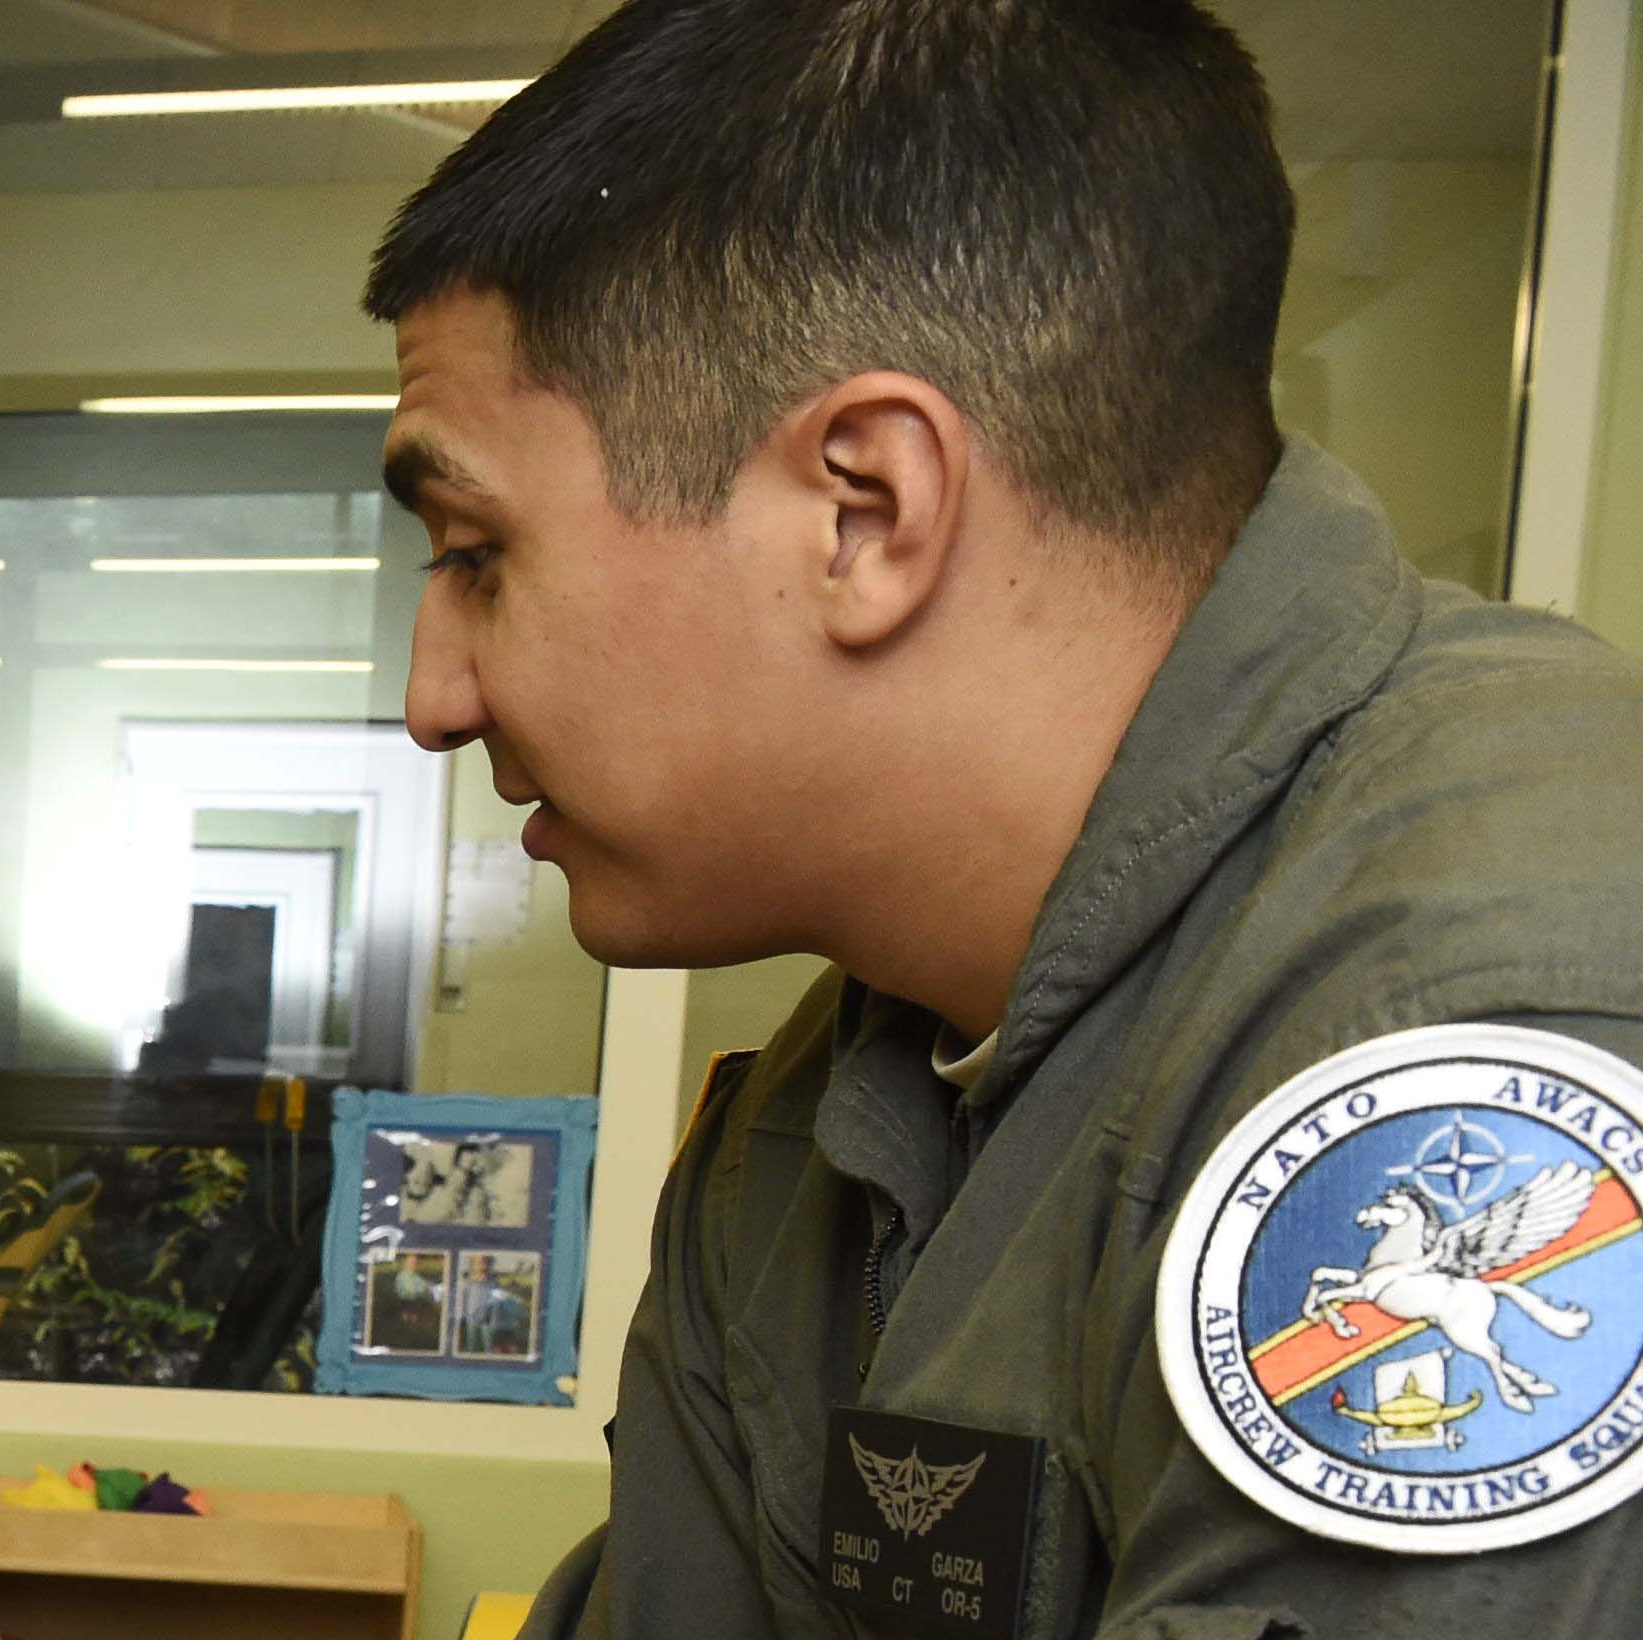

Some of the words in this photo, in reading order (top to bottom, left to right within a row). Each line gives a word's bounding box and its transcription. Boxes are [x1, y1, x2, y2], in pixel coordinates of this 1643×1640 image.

[1237, 1091, 1378, 1211] NATO
[1492, 1076, 1643, 1174] AWACS
[1206, 1305, 1301, 1468] AIRCREW
[1314, 1461, 1549, 1512] TRAINING
[1570, 1384, 1643, 1472] SQU
[832, 1562, 862, 1592] USA
[892, 1575, 915, 1604] CT
[833, 1531, 880, 1564] EMILIO
[931, 1552, 984, 1587] GARZA
